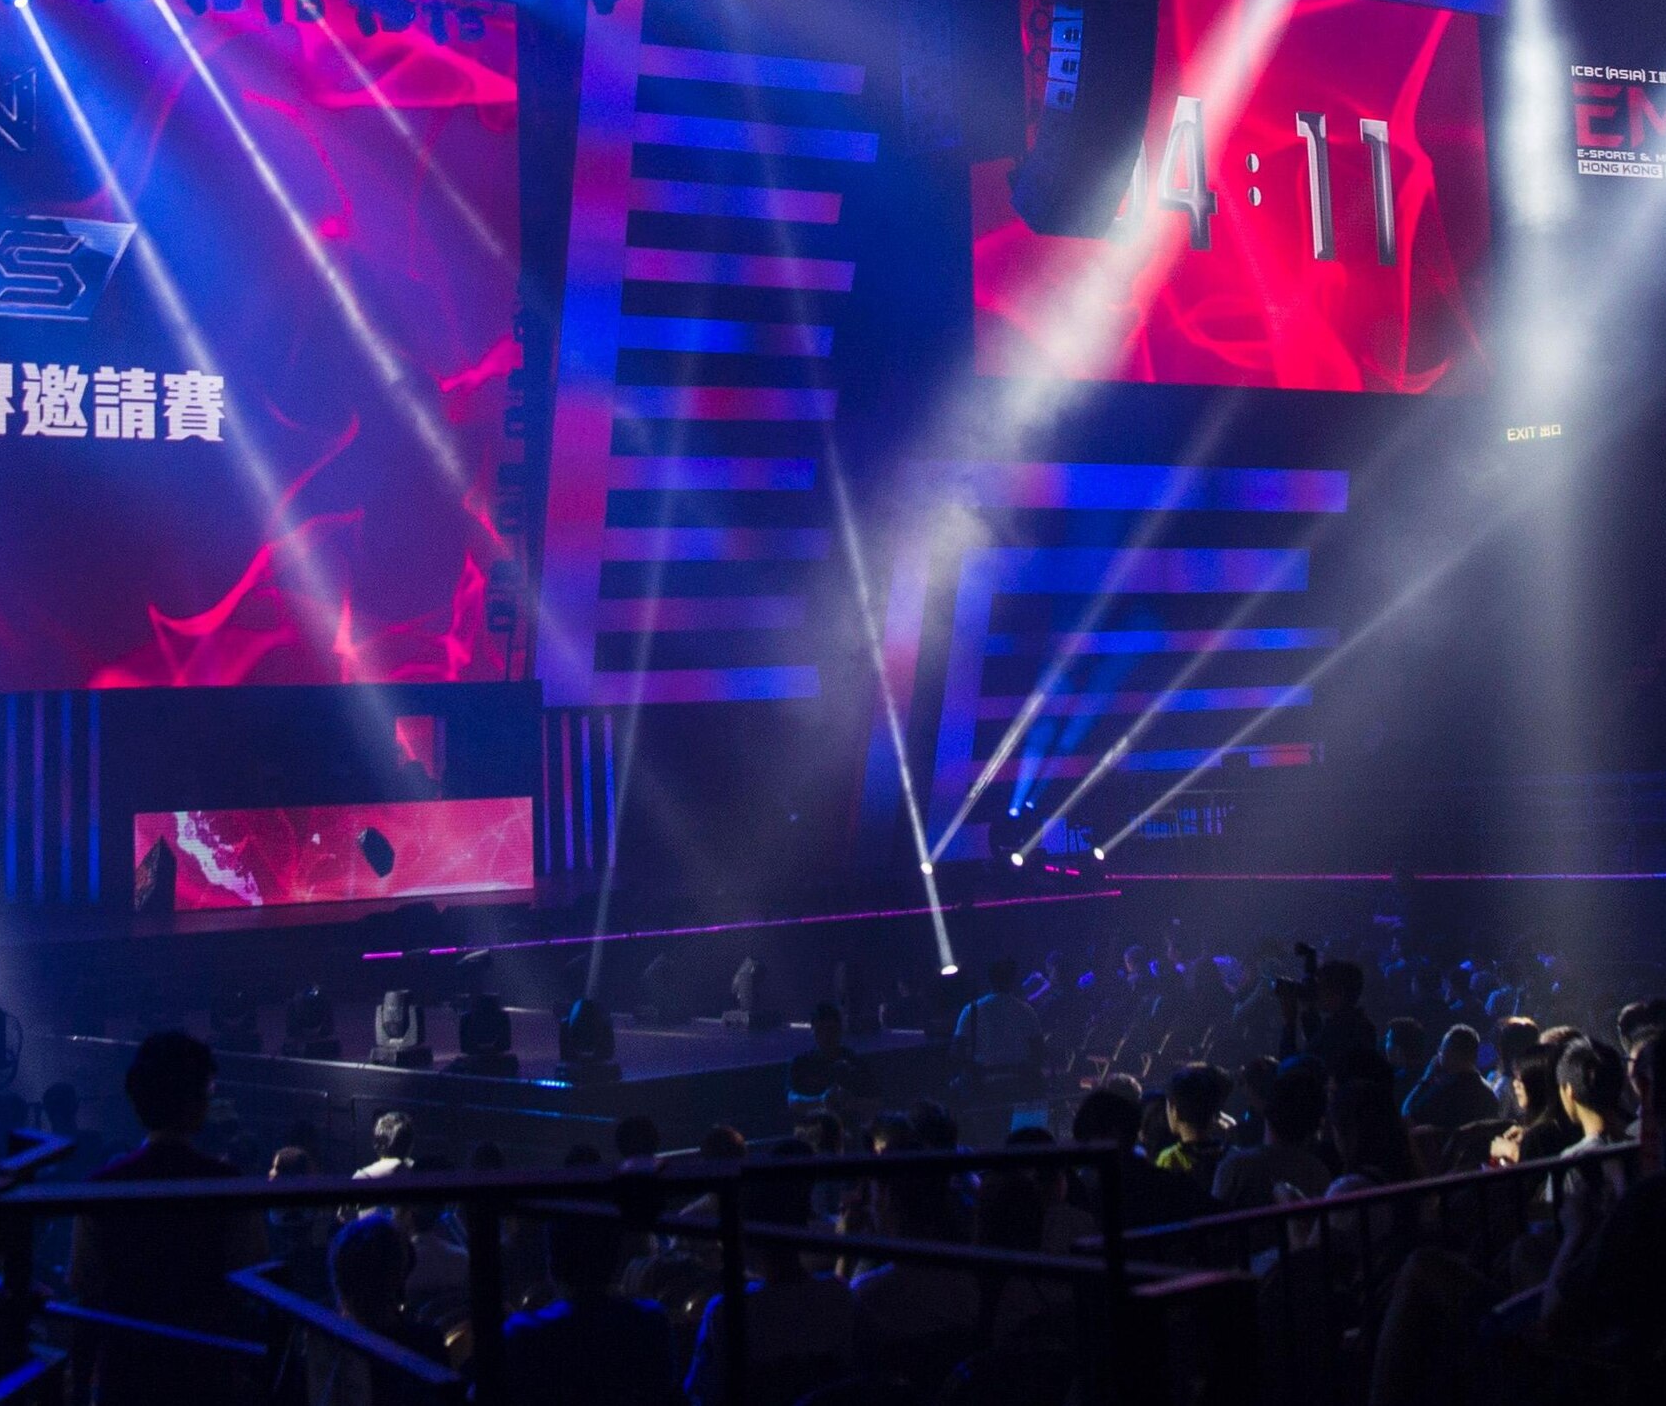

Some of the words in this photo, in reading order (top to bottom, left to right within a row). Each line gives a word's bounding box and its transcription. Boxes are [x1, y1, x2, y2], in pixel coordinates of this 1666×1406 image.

[1571, 65, 1604, 78] ICBC
[1606, 67, 1646, 83] (ASIA)
[1577, 148, 1635, 161] E-SPORTS
[1639, 152, 1652, 163] &
[1581, 161, 1619, 174] HONG
[1622, 163, 1660, 177] KONG
[1507, 426, 1537, 441] EXIT
[1540, 424, 1561, 438] 出口
